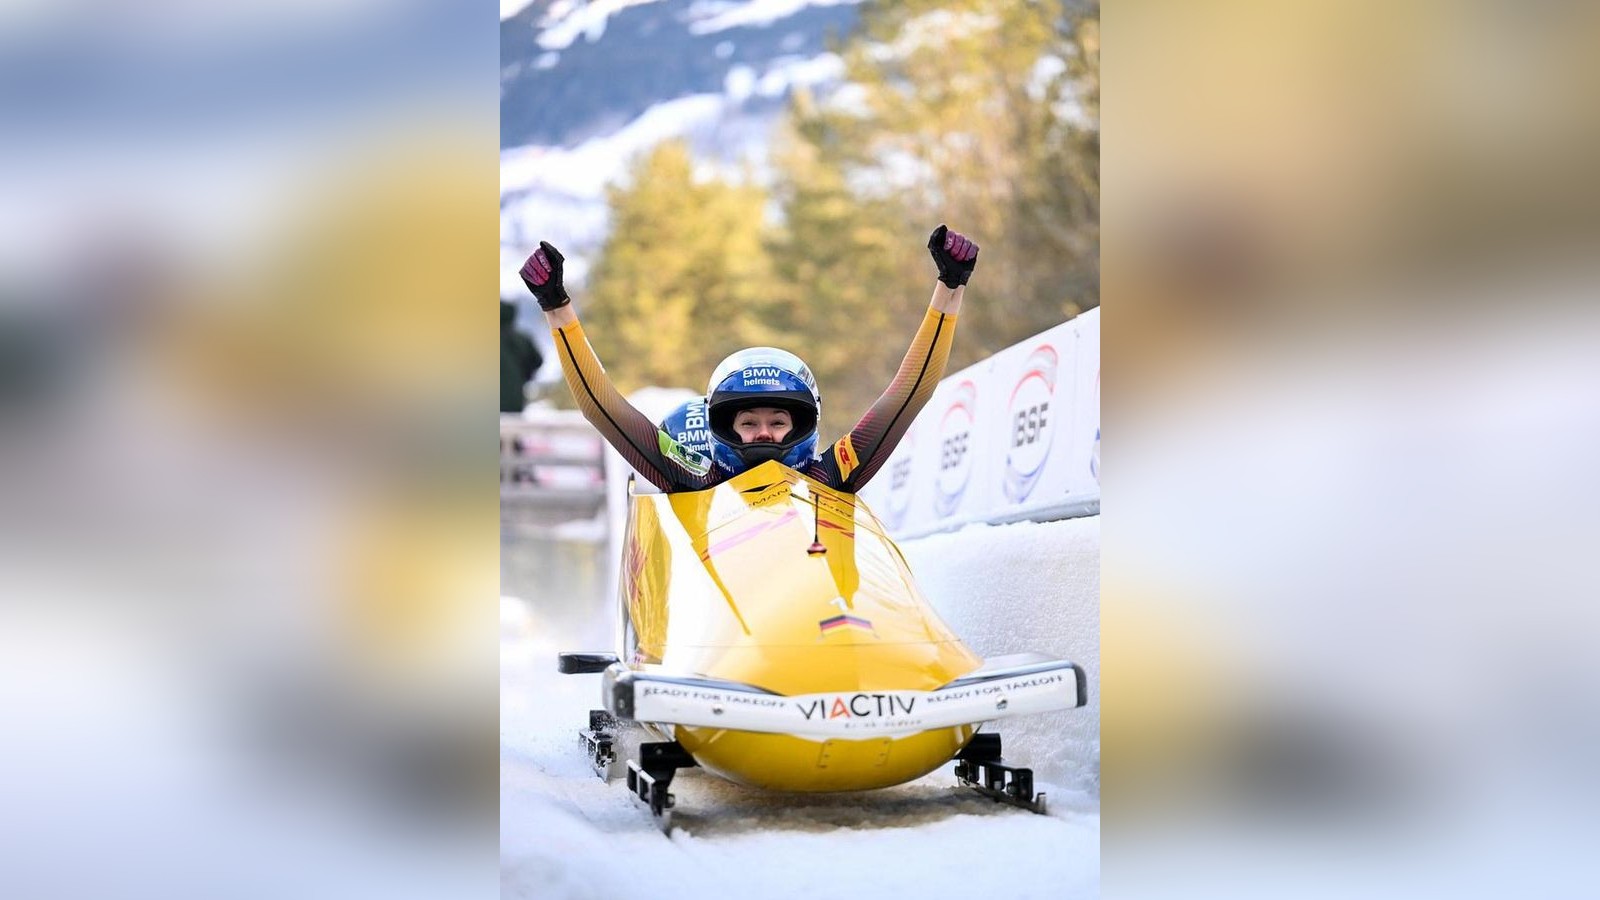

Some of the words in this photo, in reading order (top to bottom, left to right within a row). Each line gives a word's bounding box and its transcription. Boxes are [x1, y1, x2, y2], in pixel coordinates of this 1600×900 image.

[743, 368, 781, 378] BMW
[744, 378, 780, 387] helmets
[685, 399, 705, 430] BM
[1012, 402, 1049, 447] IBSF
[941, 431, 969, 471] IBSF
[643, 686, 689, 697] READY
[693, 692, 722, 700] FOR
[726, 695, 786, 708] TAKEOFF
[927, 690, 971, 703] READY
[975, 686, 1003, 696] FOR
[1006, 674, 1064, 691] TAKEOFF
[796, 694, 915, 720] VIACTIV
